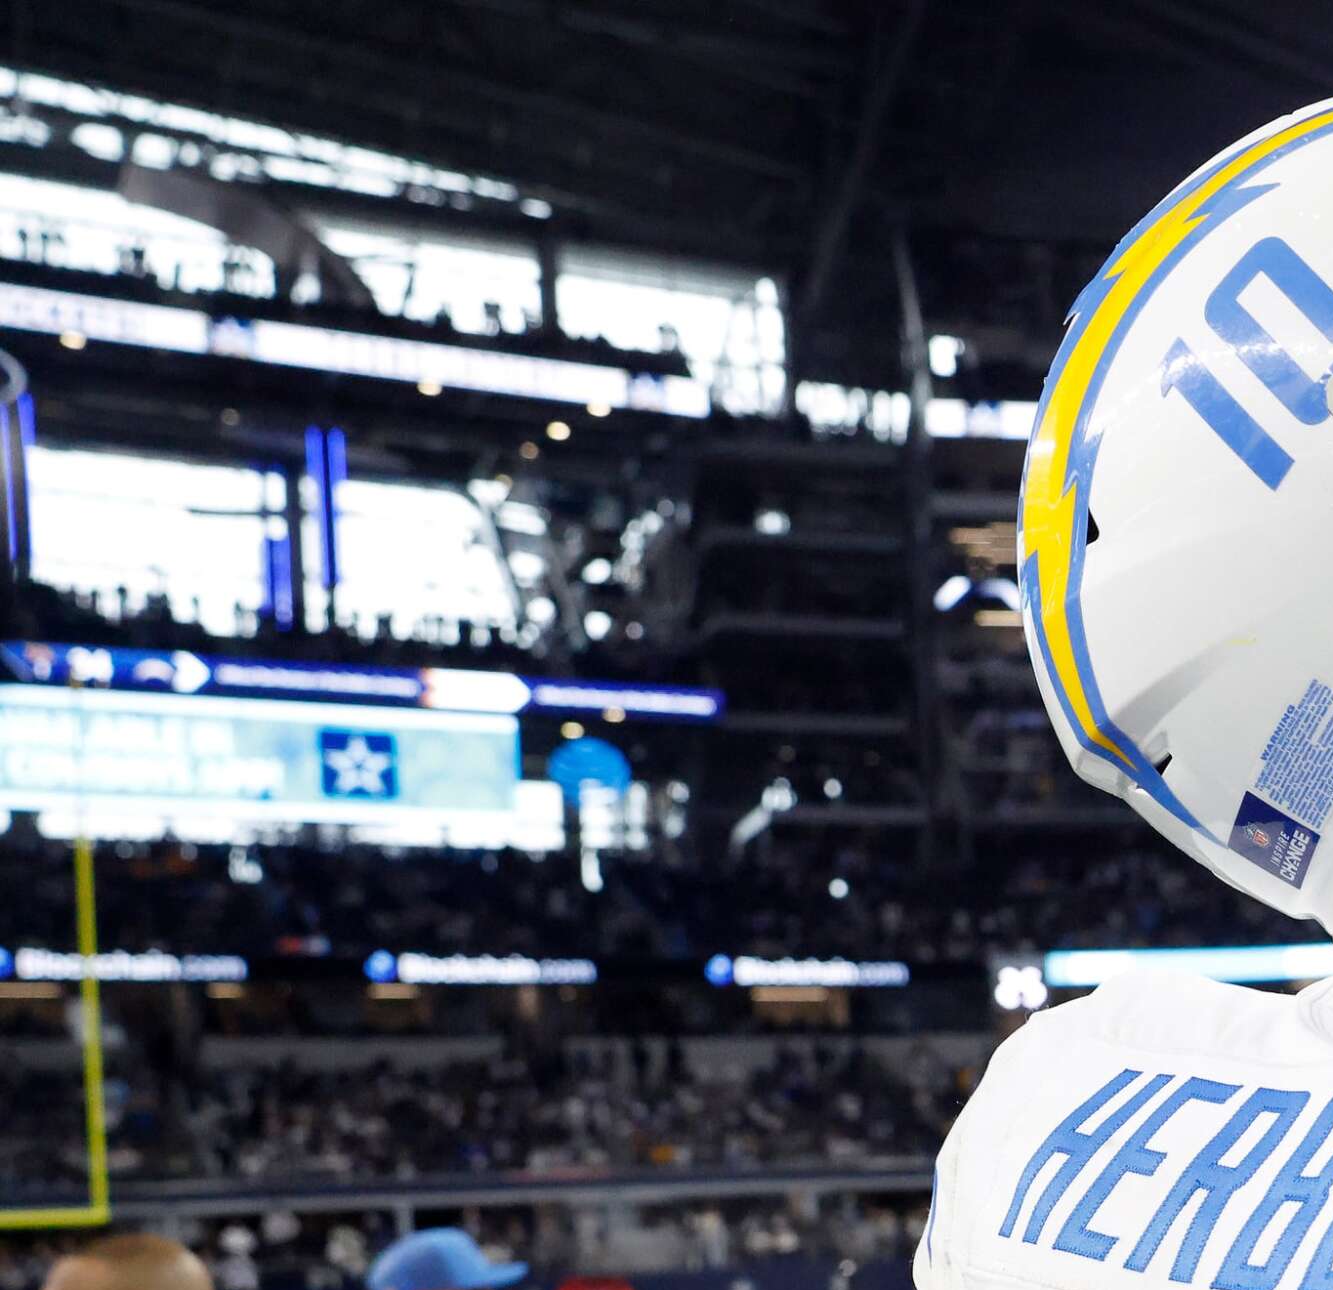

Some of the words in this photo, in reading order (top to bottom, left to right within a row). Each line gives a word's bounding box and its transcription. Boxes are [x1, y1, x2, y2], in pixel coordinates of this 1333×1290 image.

[1261, 704, 1295, 761] WARNING
[1270, 830, 1290, 867] INSPIRE
[1279, 829, 1310, 881] CHANGE
